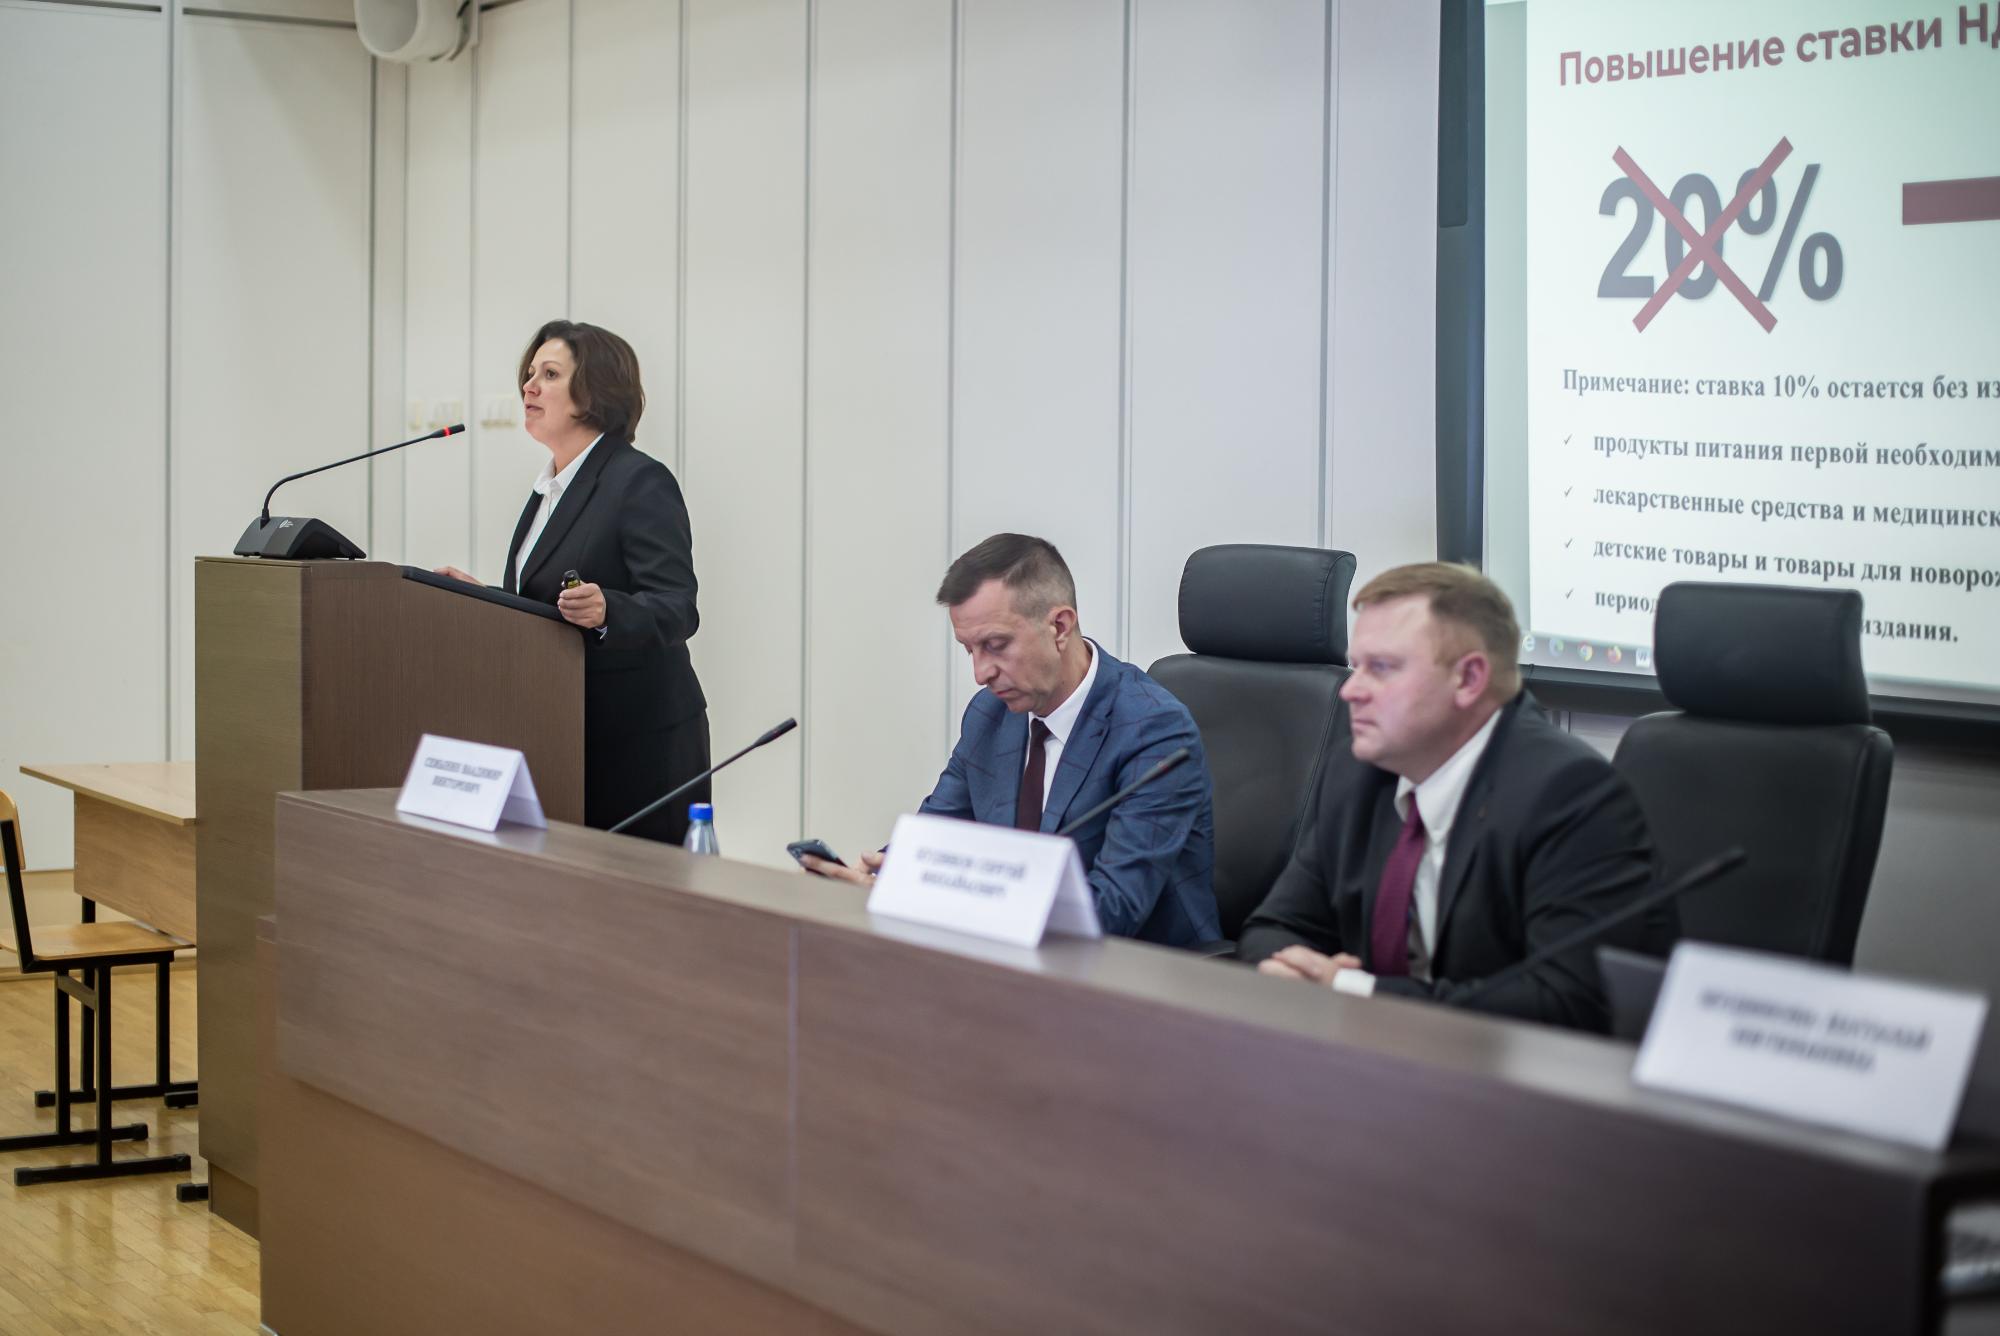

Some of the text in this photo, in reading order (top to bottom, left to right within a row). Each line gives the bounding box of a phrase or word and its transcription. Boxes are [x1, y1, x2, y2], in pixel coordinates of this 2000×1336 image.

[1560, 2, 2000, 86] Повышение ставки Н
[1597, 163, 1844, 302] 20%
[1563, 369, 1689, 396] Примечание:
[1696, 379, 1765, 397] ставка
[1774, 374, 1820, 399] 10%
[1827, 380, 1924, 399] остается
[1933, 375, 1968, 399] без
[1594, 436, 2000, 469] продукты питания первой необходим
[1593, 488, 2000, 528] лекарственные средства и медицинск
[1593, 541, 2000, 592] детские товары и товары для новоро
